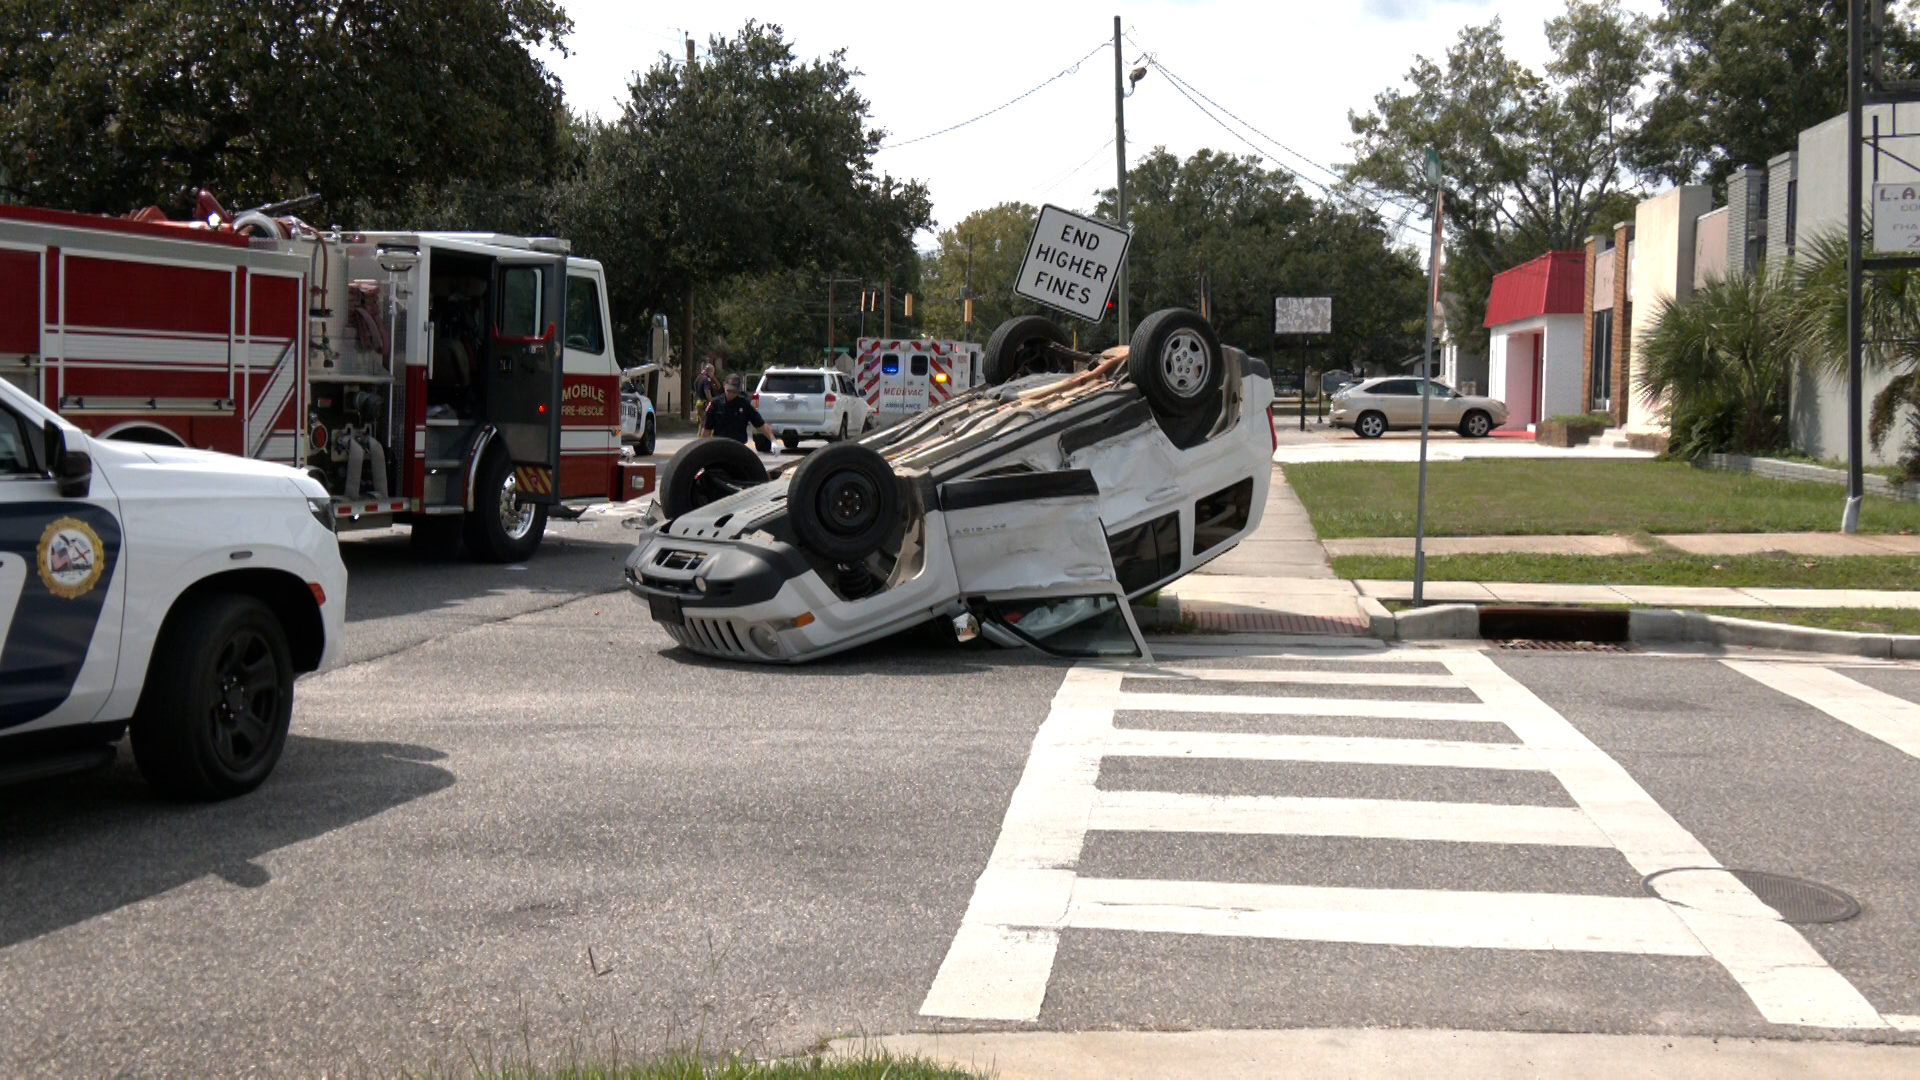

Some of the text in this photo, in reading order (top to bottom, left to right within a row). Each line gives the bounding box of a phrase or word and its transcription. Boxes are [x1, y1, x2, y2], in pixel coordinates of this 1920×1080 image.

[1061, 224, 1100, 251] END
[1035, 243, 1108, 284] HIGHER
[1034, 271, 1091, 305] FINES
[562, 383, 605, 404] MOBILE
[561, 405, 605, 416] FIRE-RESCUE
